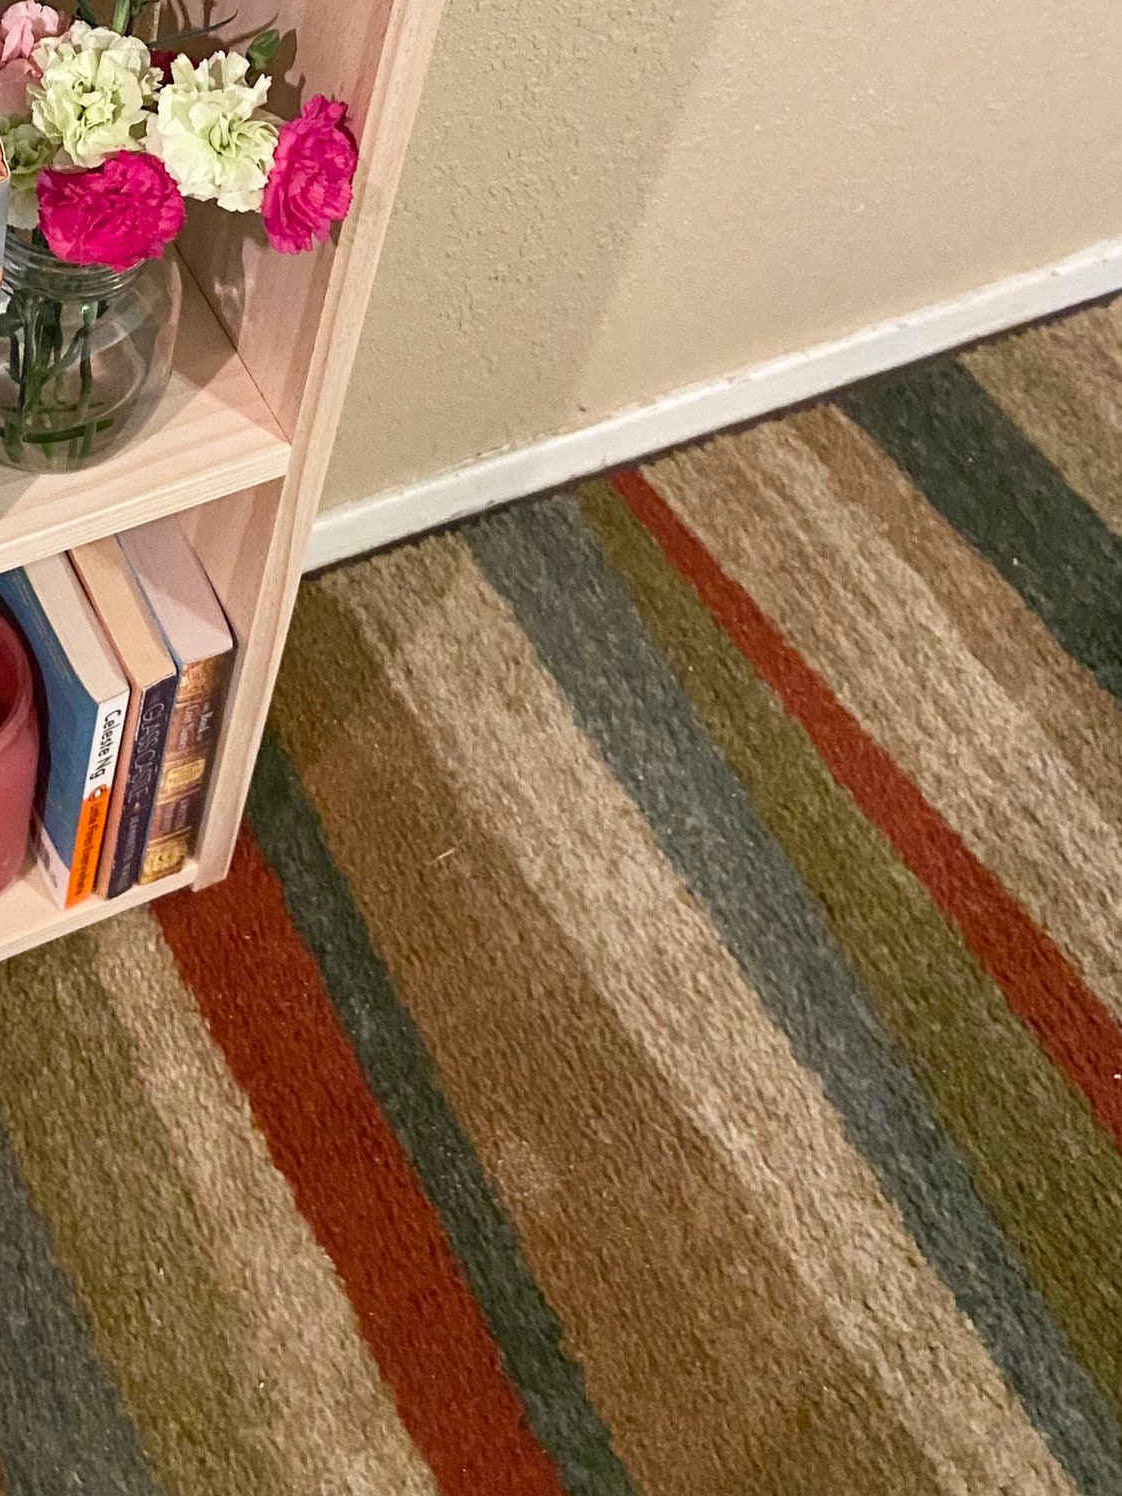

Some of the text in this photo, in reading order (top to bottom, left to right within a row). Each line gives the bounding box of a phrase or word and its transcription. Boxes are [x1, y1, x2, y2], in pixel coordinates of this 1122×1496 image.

[89, 709, 122, 781] Celeste Ng
[137, 703, 165, 754] GLASS
[127, 749, 156, 804] CASTLE
